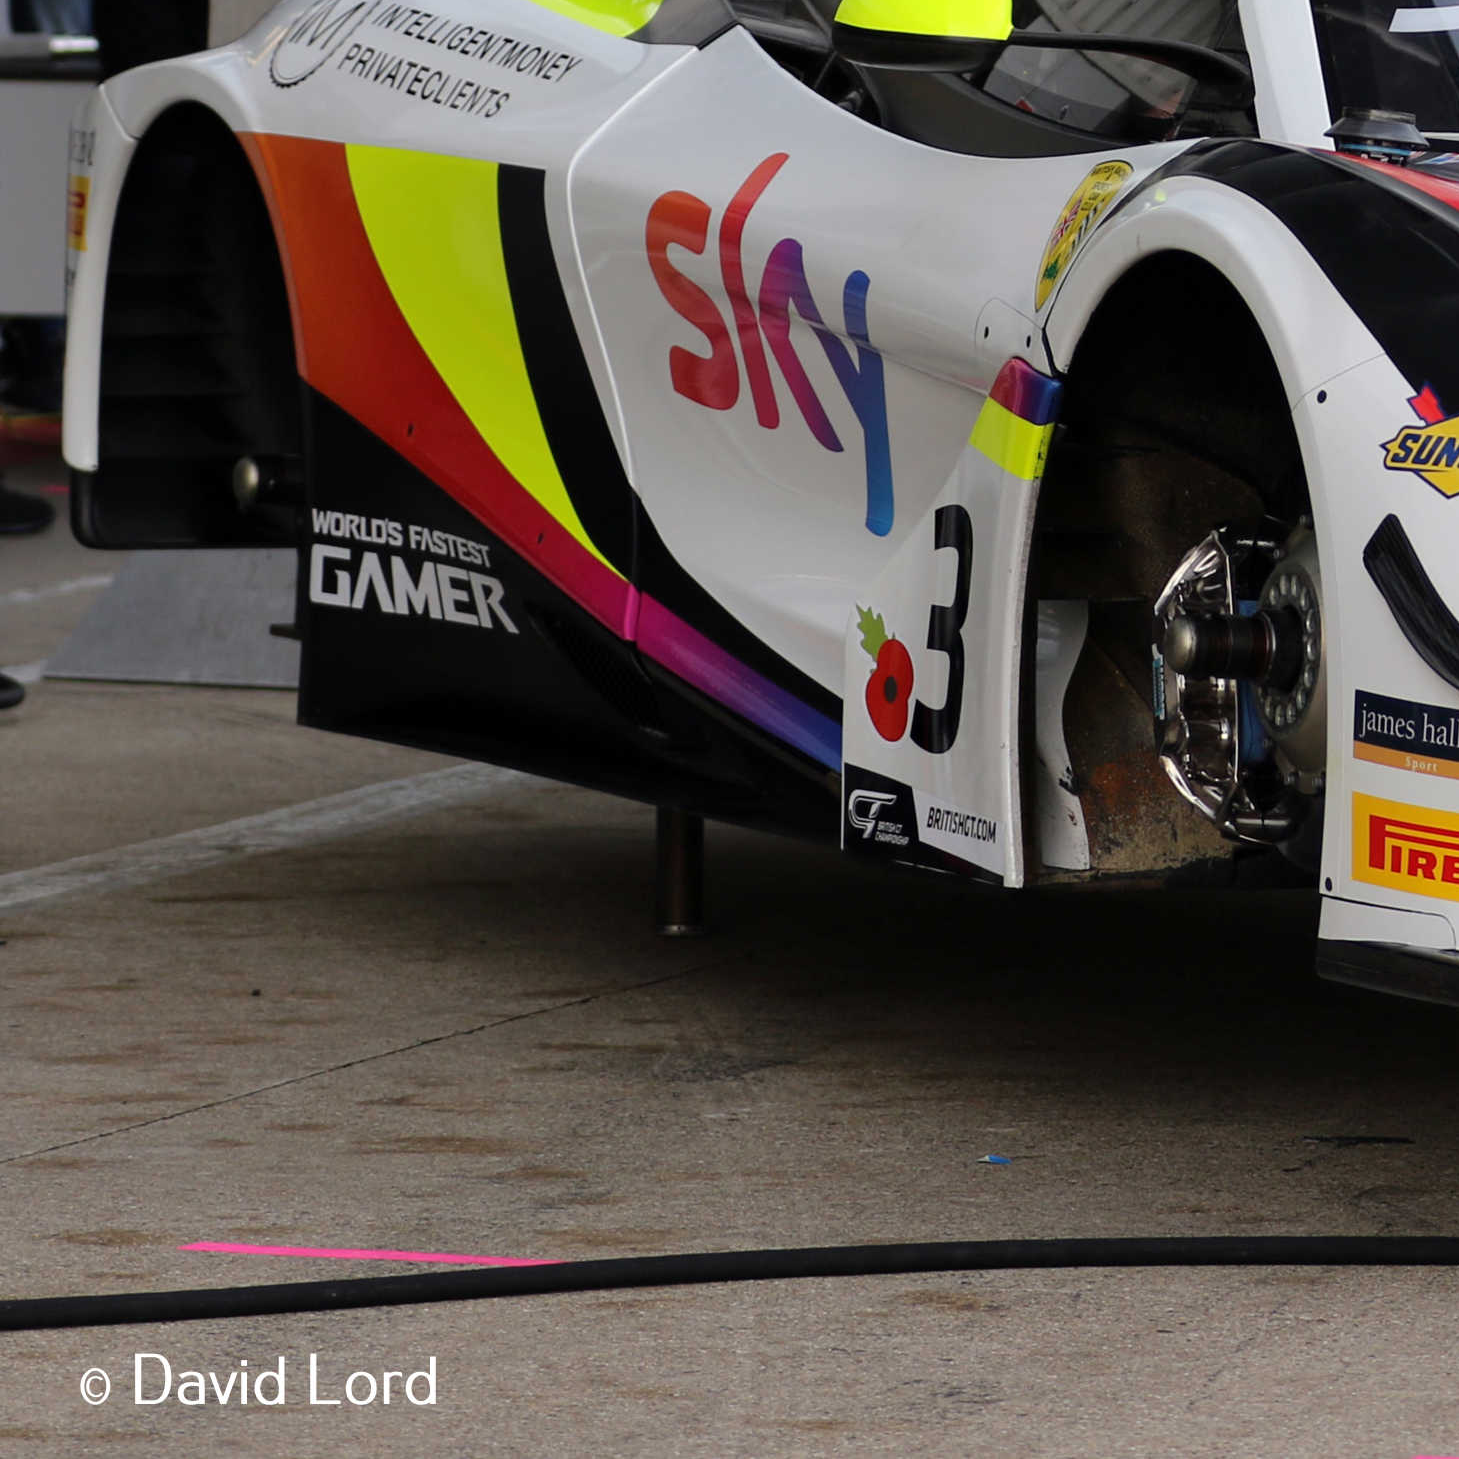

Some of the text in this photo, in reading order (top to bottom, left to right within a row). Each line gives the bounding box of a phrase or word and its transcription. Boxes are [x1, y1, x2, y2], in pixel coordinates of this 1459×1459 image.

[337, 42, 511, 119] PRIVATECLIENTS
[373, 2, 583, 83] INTELLIGENTMONEY
[645, 151, 895, 538] sky
[311, 507, 492, 568] WORLD'S FASTEST
[308, 543, 520, 635] GAMER
[910, 504, 974, 754] 3
[1359, 702, 1416, 739] james
[1404, 756, 1439, 774] Sport
[926, 806, 997, 844] BRITISHGT.COM
